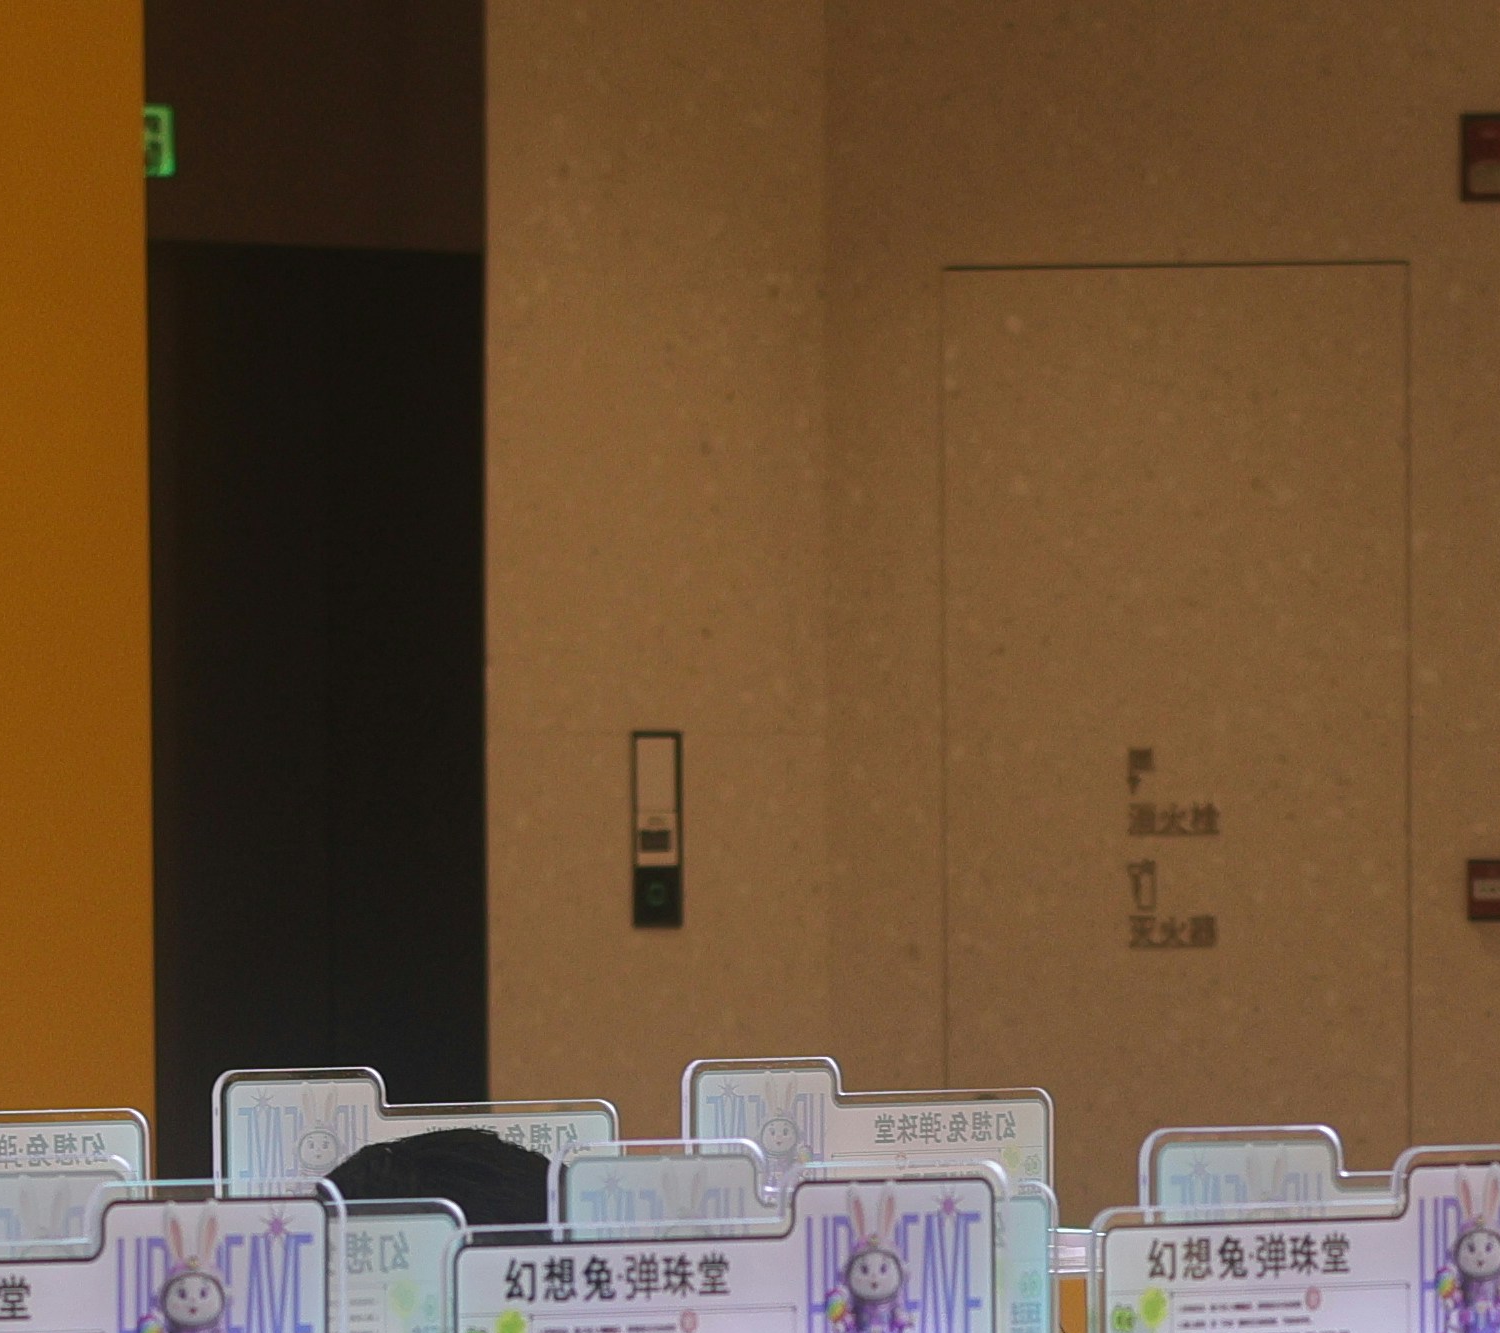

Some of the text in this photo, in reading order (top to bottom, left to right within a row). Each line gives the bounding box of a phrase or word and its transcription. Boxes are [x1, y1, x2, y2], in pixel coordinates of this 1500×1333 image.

[504, 1251, 731, 1304] 幻想兔·弹珠堂
[1147, 1231, 1352, 1281] 幻想兔·弹珠堂
